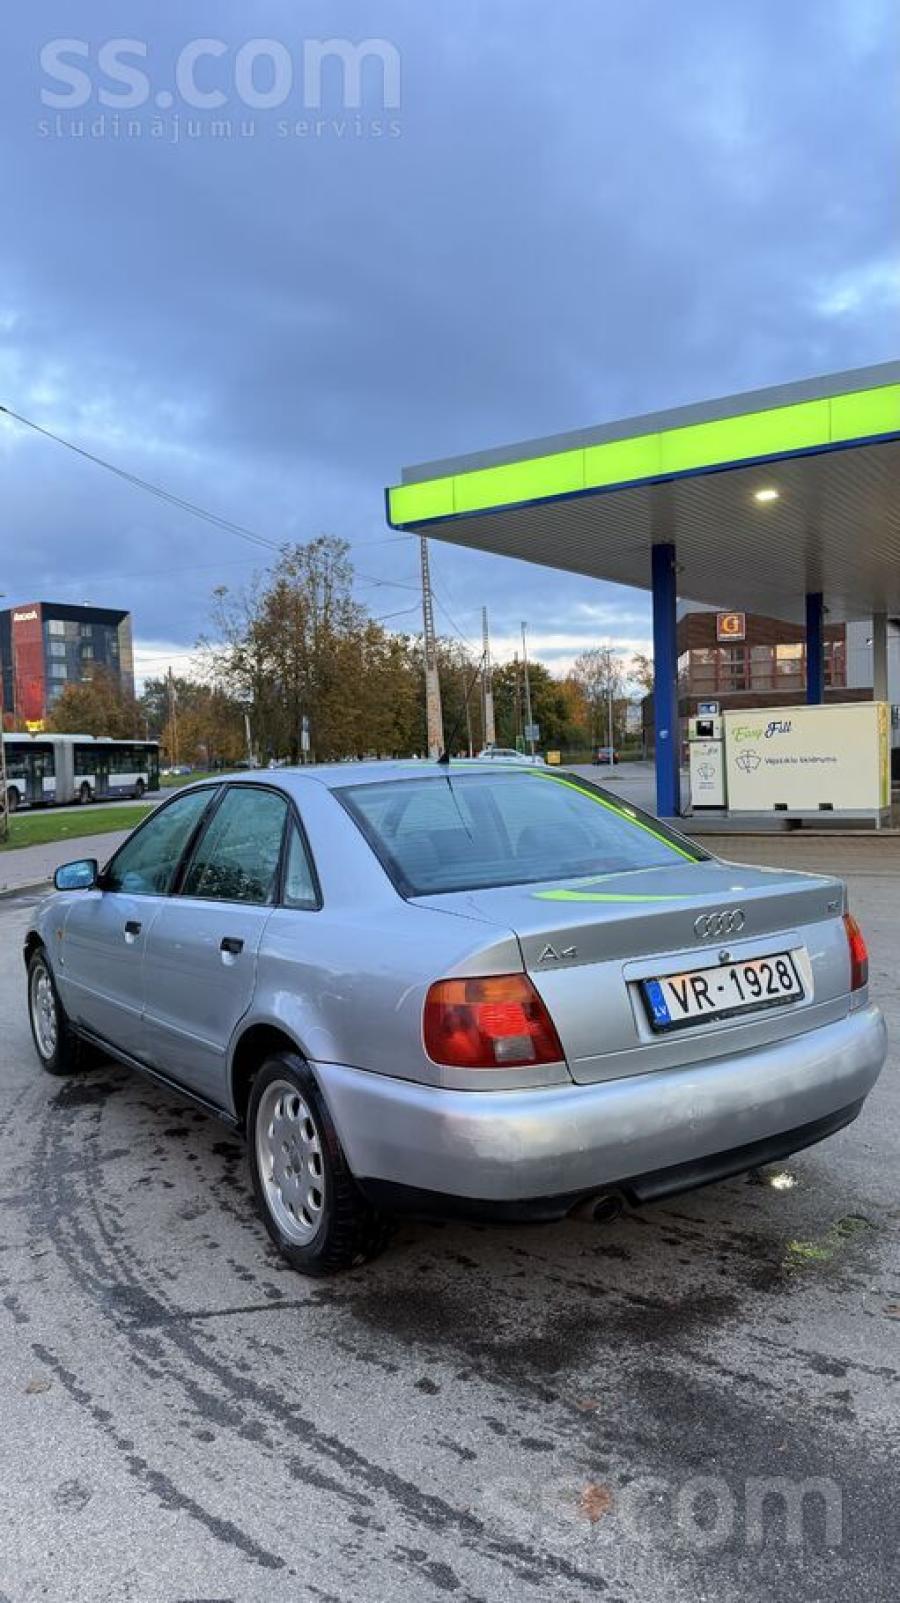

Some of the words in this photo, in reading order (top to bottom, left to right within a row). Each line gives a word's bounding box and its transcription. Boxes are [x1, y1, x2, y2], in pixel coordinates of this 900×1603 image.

[537, 943, 577, 961] A4
[668, 959, 794, 1014] VR-1928
[654, 1006, 667, 1017] LV
